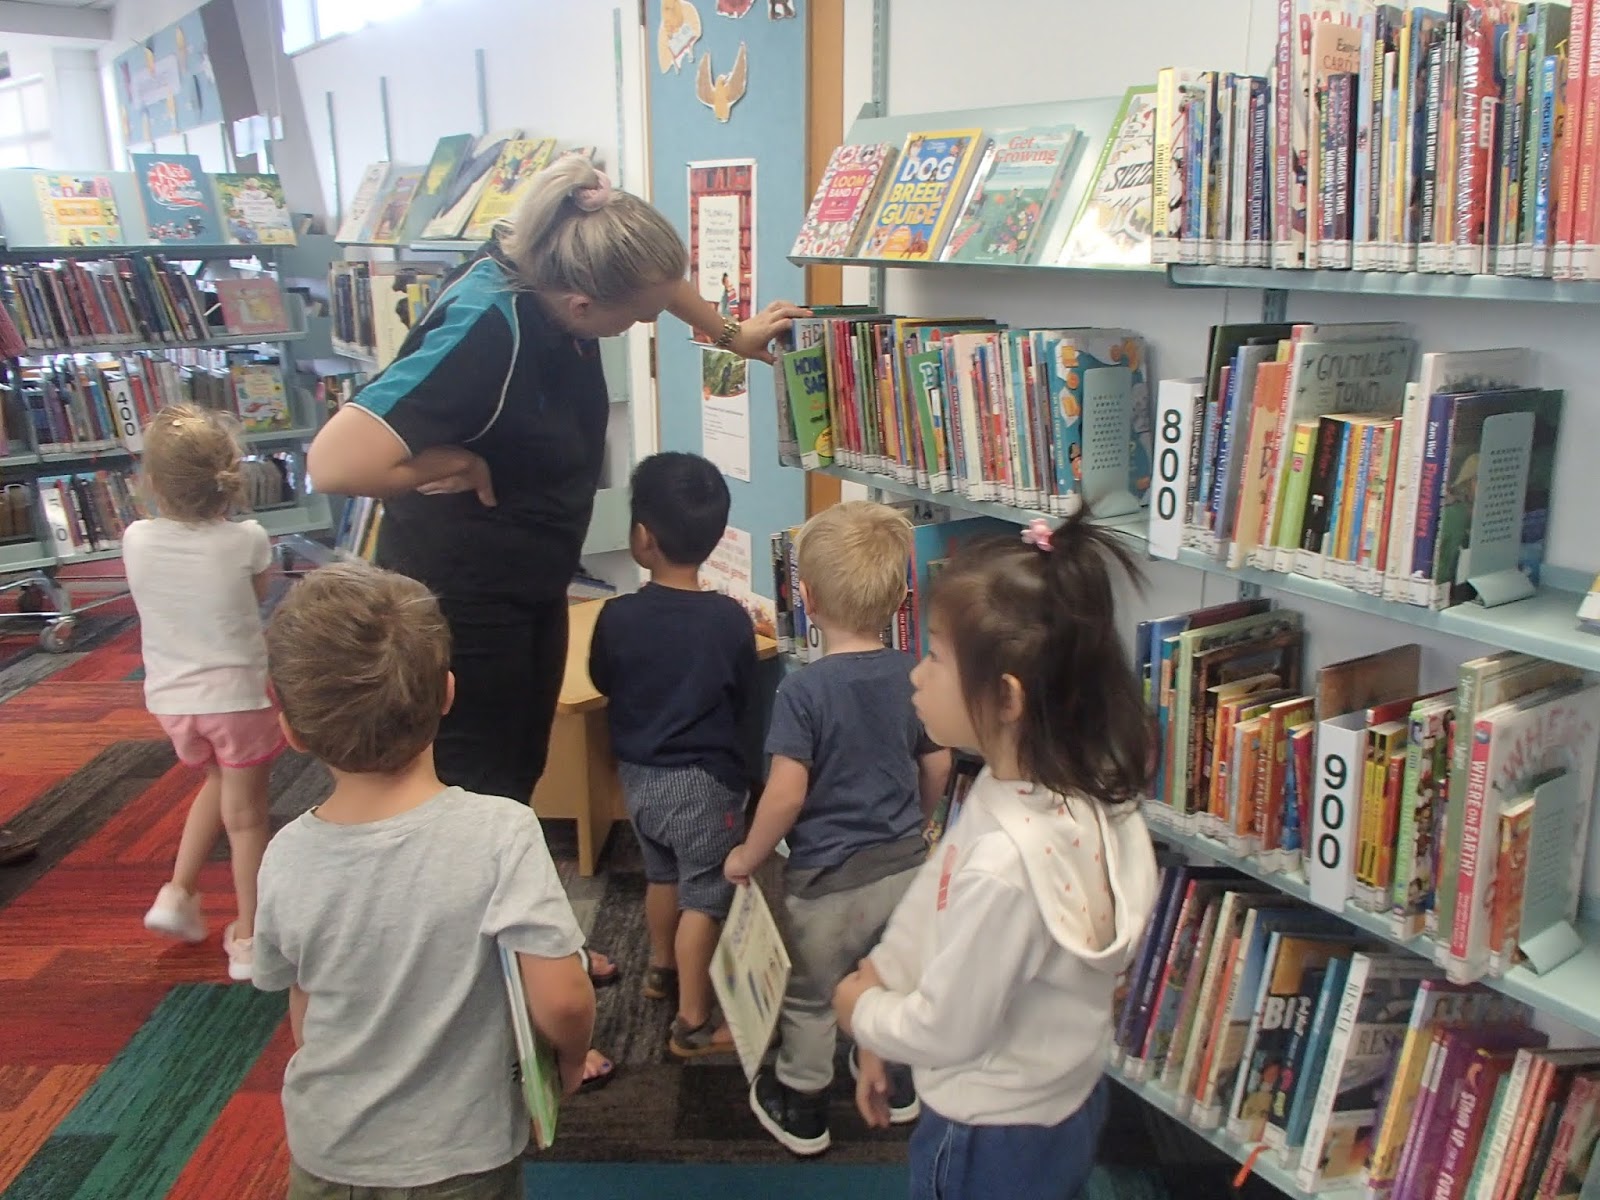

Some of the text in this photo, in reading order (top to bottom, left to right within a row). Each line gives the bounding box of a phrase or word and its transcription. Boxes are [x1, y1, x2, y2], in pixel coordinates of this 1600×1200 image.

[1008, 136, 1035, 149] Get
[832, 174, 868, 188] LOOM
[900, 156, 957, 182] DOG
[827, 186, 853, 198] BAND
[117, 390, 137, 437] 400
[1157, 408, 1182, 521] 800
[1468, 760, 1486, 808] WHERE
[1318, 753, 1347, 869] 900
[1466, 808, 1479, 824] ON
[1460, 822, 1480, 877] EARTH?
